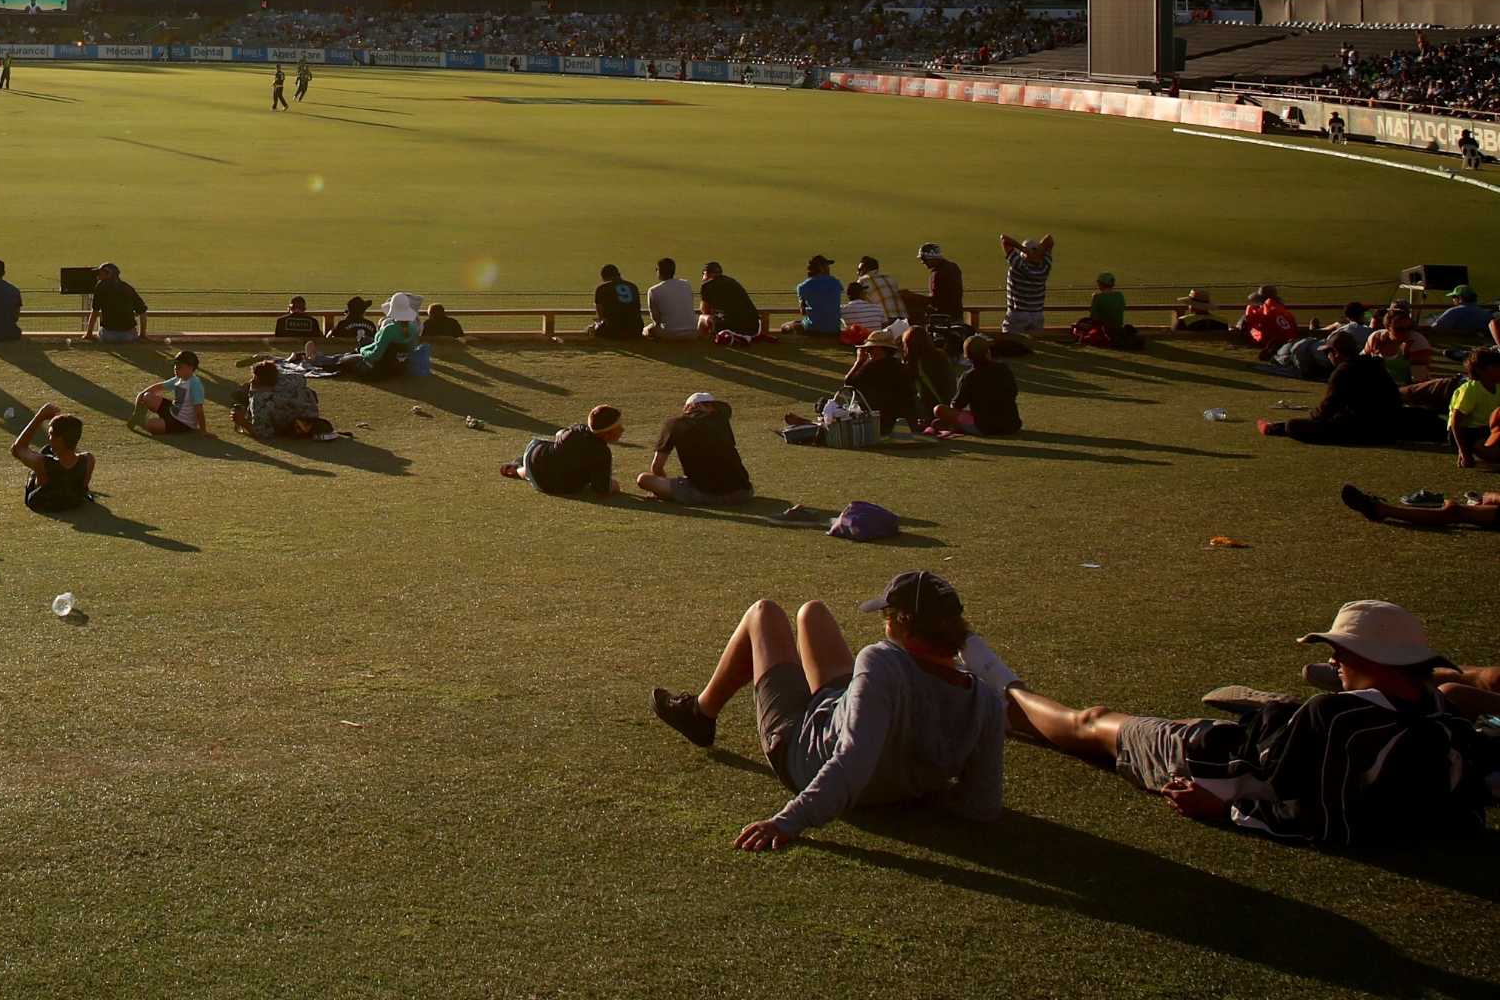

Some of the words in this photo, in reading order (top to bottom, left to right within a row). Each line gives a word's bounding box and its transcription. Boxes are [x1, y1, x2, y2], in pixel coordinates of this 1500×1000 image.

[106, 47, 144, 57] Medical
[193, 47, 224, 57] Dental
[564, 58, 596, 69] Dental
[1376, 115, 1462, 146] MATADOR
[1473, 126, 1500, 150] BB
[616, 283, 633, 303] 9
